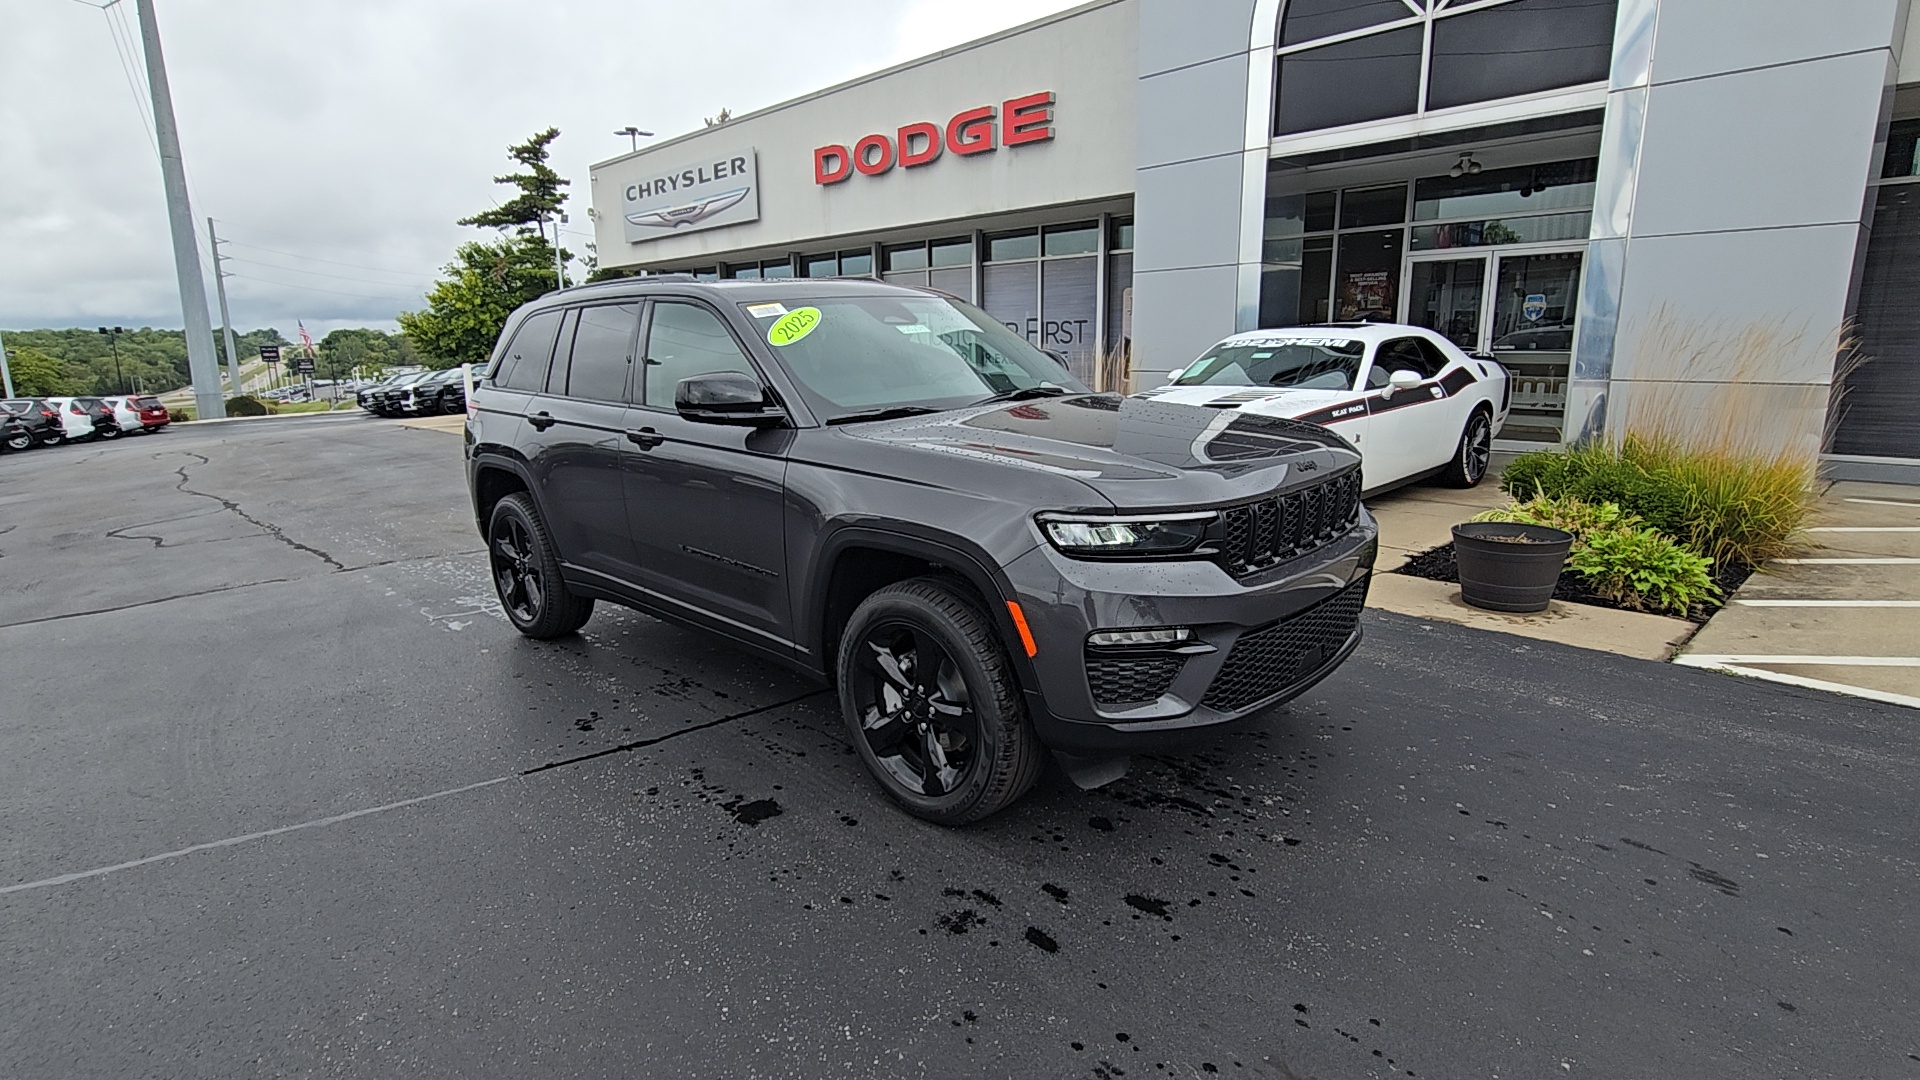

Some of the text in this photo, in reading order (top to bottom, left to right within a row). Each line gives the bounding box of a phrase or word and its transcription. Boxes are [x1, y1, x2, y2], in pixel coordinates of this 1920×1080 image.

[814, 91, 1056, 185] DODGE
[626, 156, 747, 201] CHRYSLER
[777, 310, 815, 341] 2025
[1026, 318, 1088, 345] FIRST
[1284, 337, 1350, 348] HEMI
[1348, 404, 1365, 414] PACK
[1295, 460, 1318, 473] Jeep
